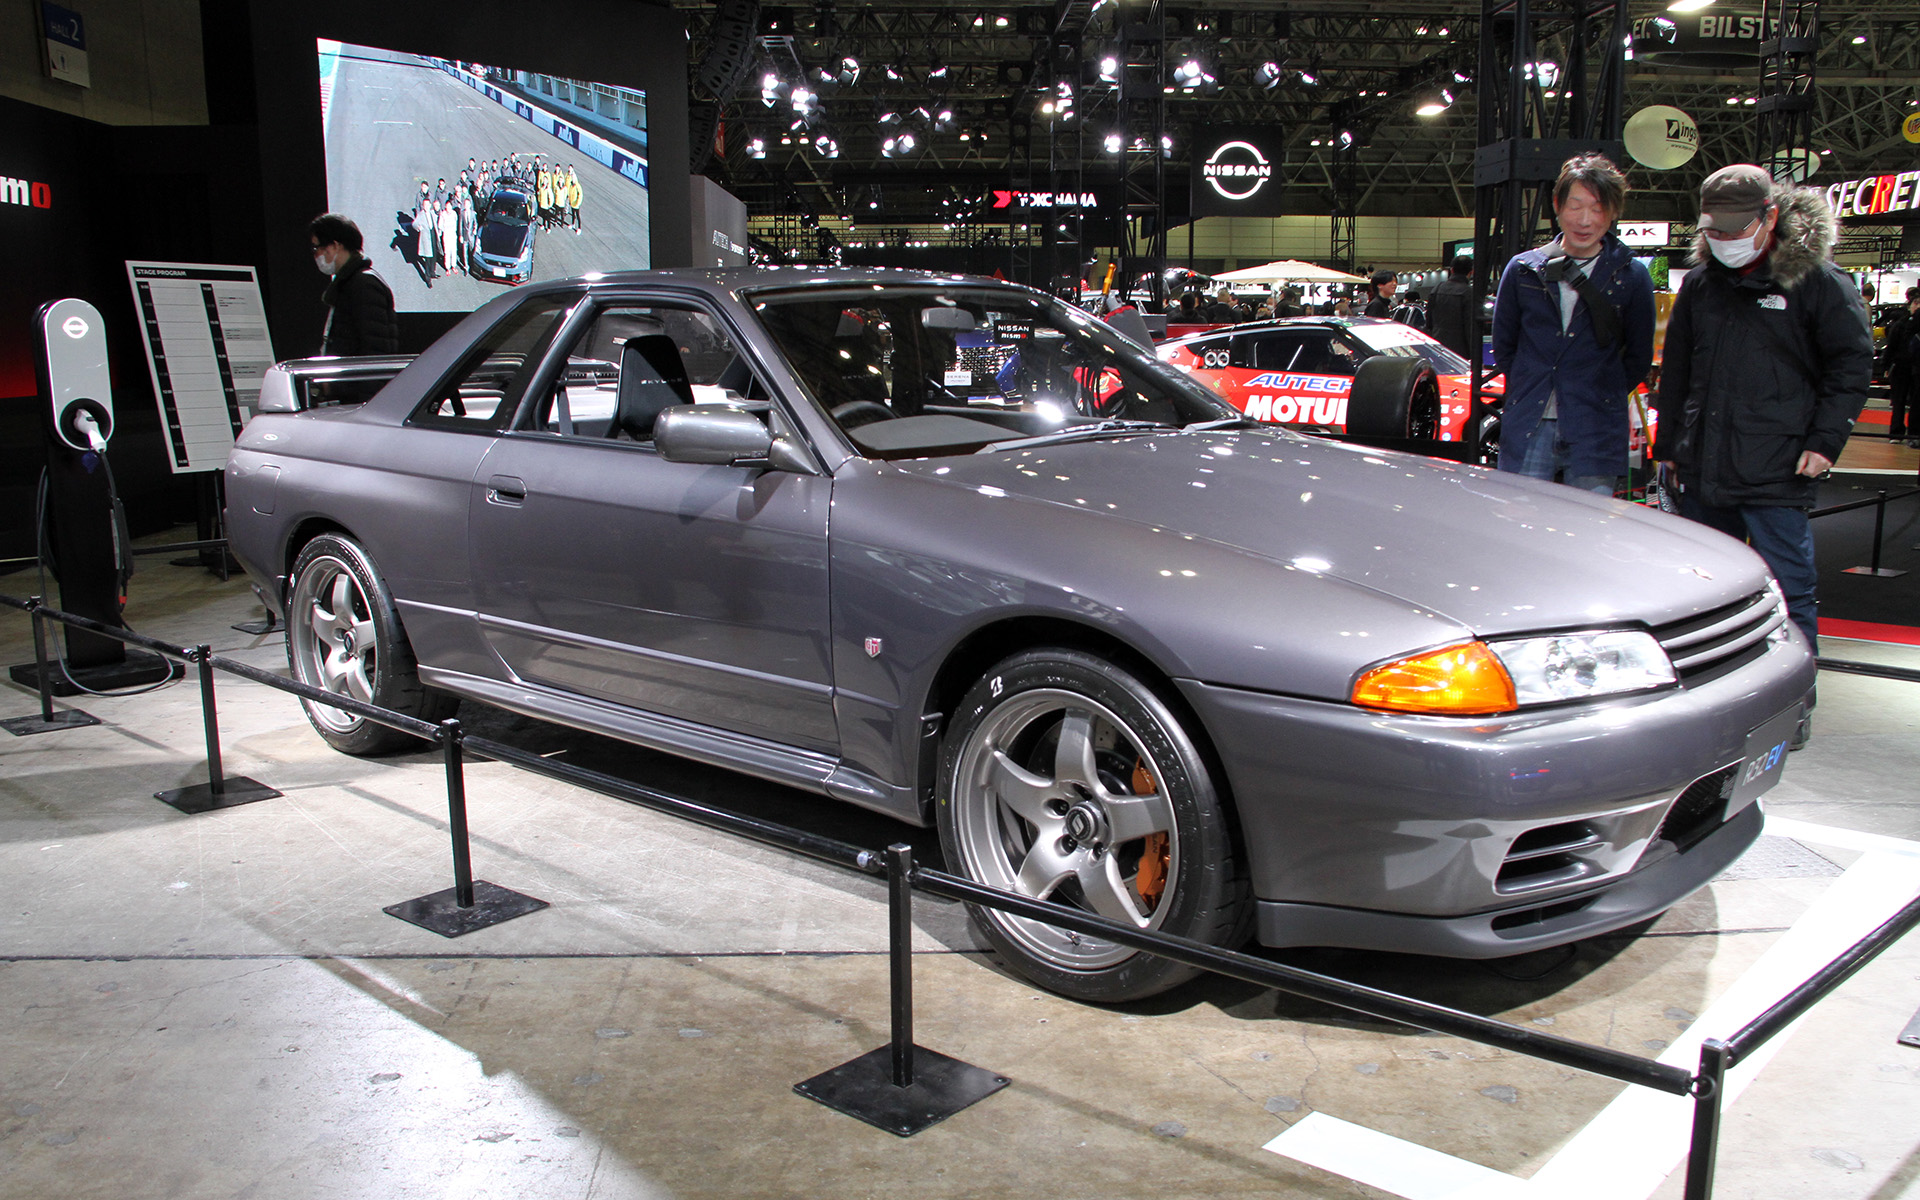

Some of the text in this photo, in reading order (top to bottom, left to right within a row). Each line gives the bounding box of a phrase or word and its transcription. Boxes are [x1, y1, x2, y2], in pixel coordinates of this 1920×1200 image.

[70, 18, 80, 41] 2
[1203, 164, 1271, 176] NISSAN
[997, 324, 1030, 332] NISSAN
